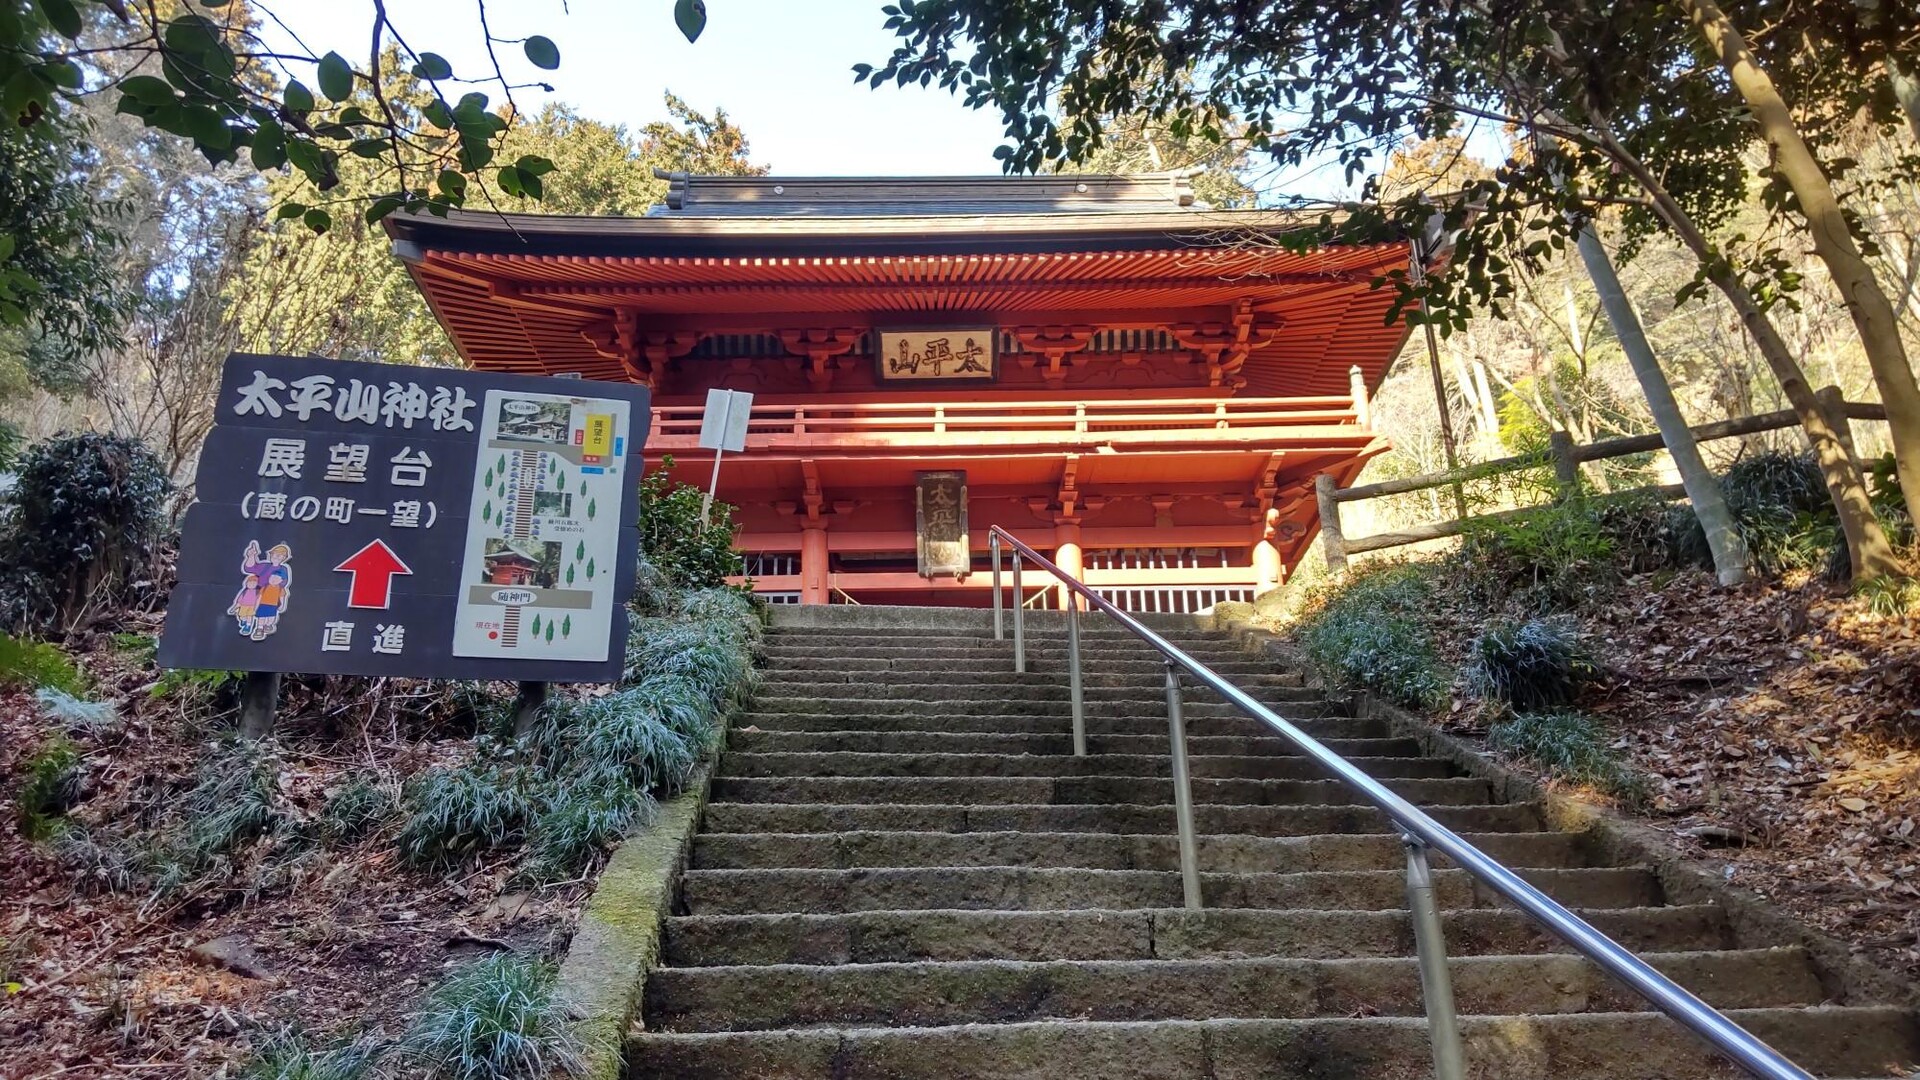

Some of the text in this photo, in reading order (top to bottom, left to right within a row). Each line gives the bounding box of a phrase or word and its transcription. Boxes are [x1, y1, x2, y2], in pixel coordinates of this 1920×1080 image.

[233, 369, 478, 433] 太平山神社
[257, 439, 433, 487] 展望台
[240, 491, 438, 529] (蔵の町一望)
[497, 591, 531, 603] 随神門
[321, 620, 409, 655] 直進
